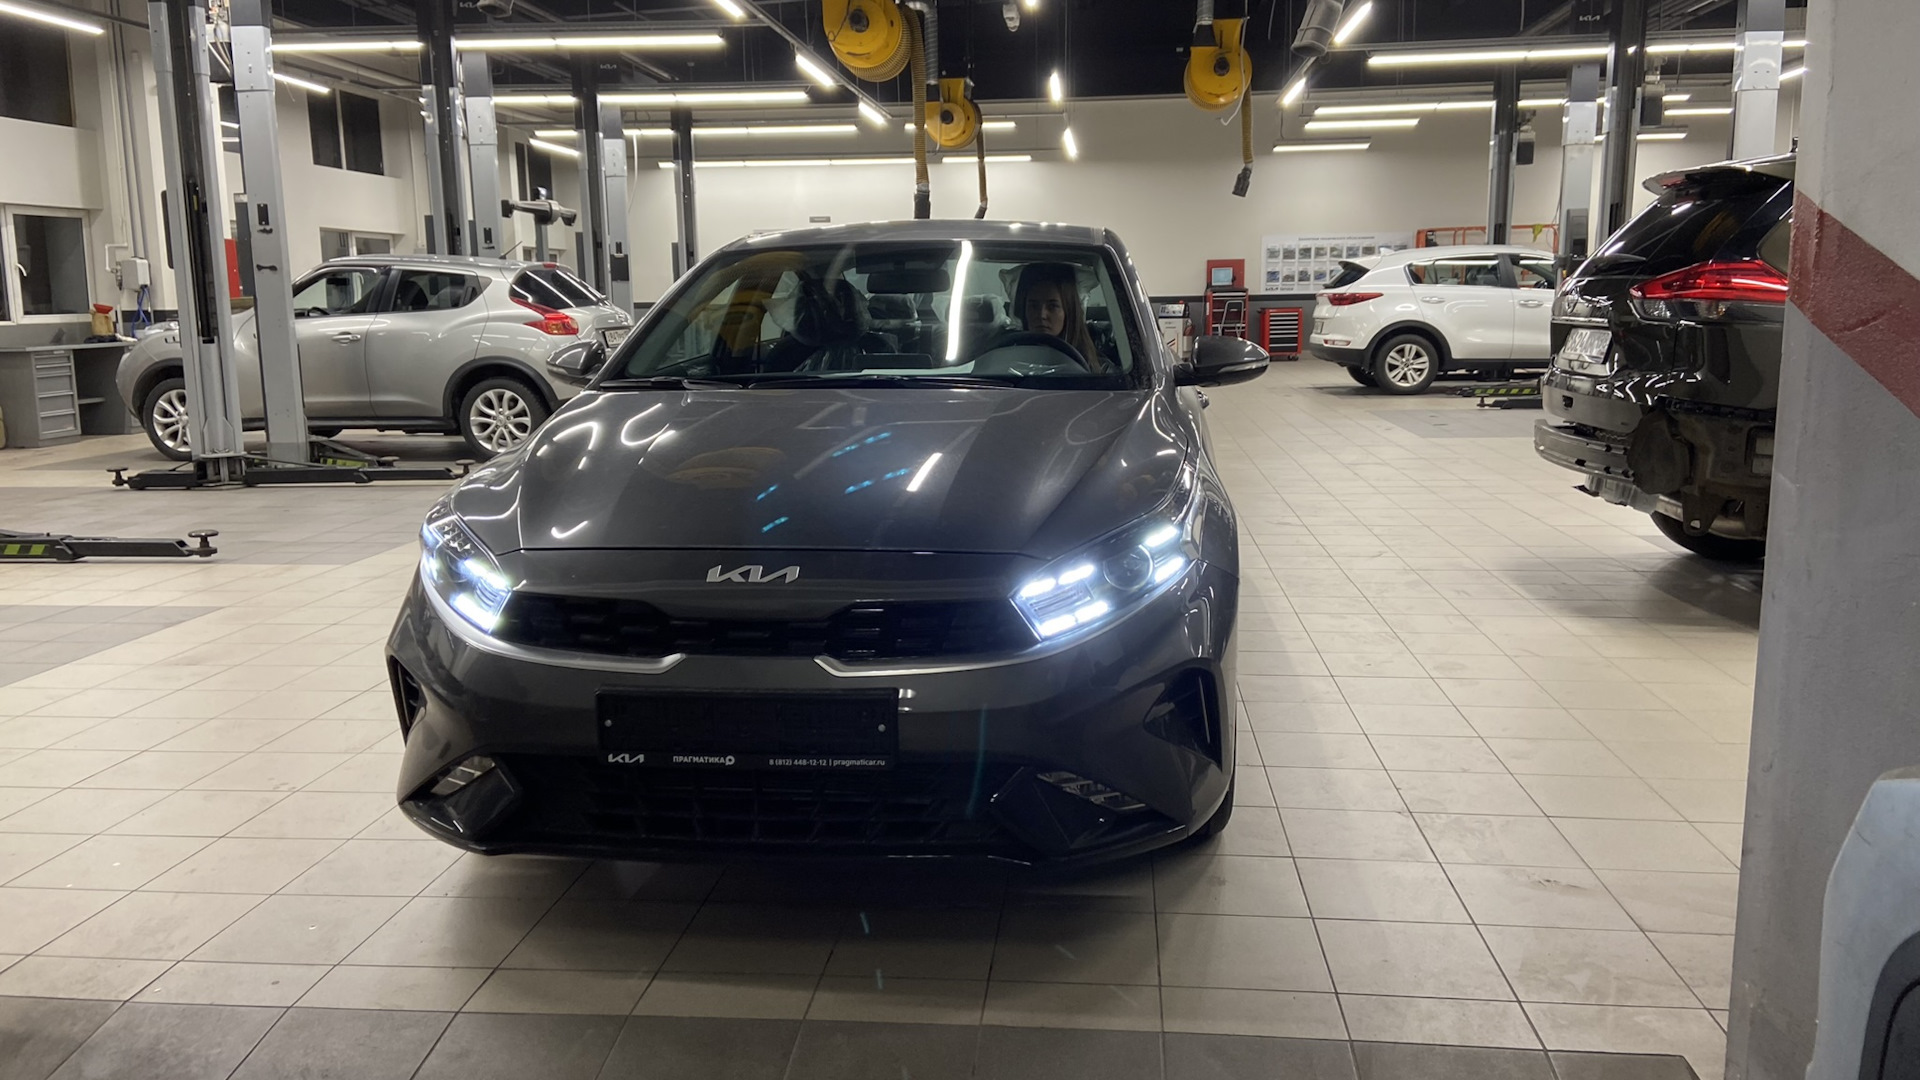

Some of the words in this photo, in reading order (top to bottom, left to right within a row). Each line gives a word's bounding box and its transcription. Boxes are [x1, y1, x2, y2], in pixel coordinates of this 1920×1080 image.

[706, 564, 800, 584] KIA
[608, 753, 644, 763] KIA
[672, 755, 725, 764] ПРАГМАТИКА
[768, 758, 774, 766] 8
[775, 758, 792, 766] (812)
[793, 758, 827, 766] 448-12-12
[833, 759, 886, 768] pragmaticar.ru
